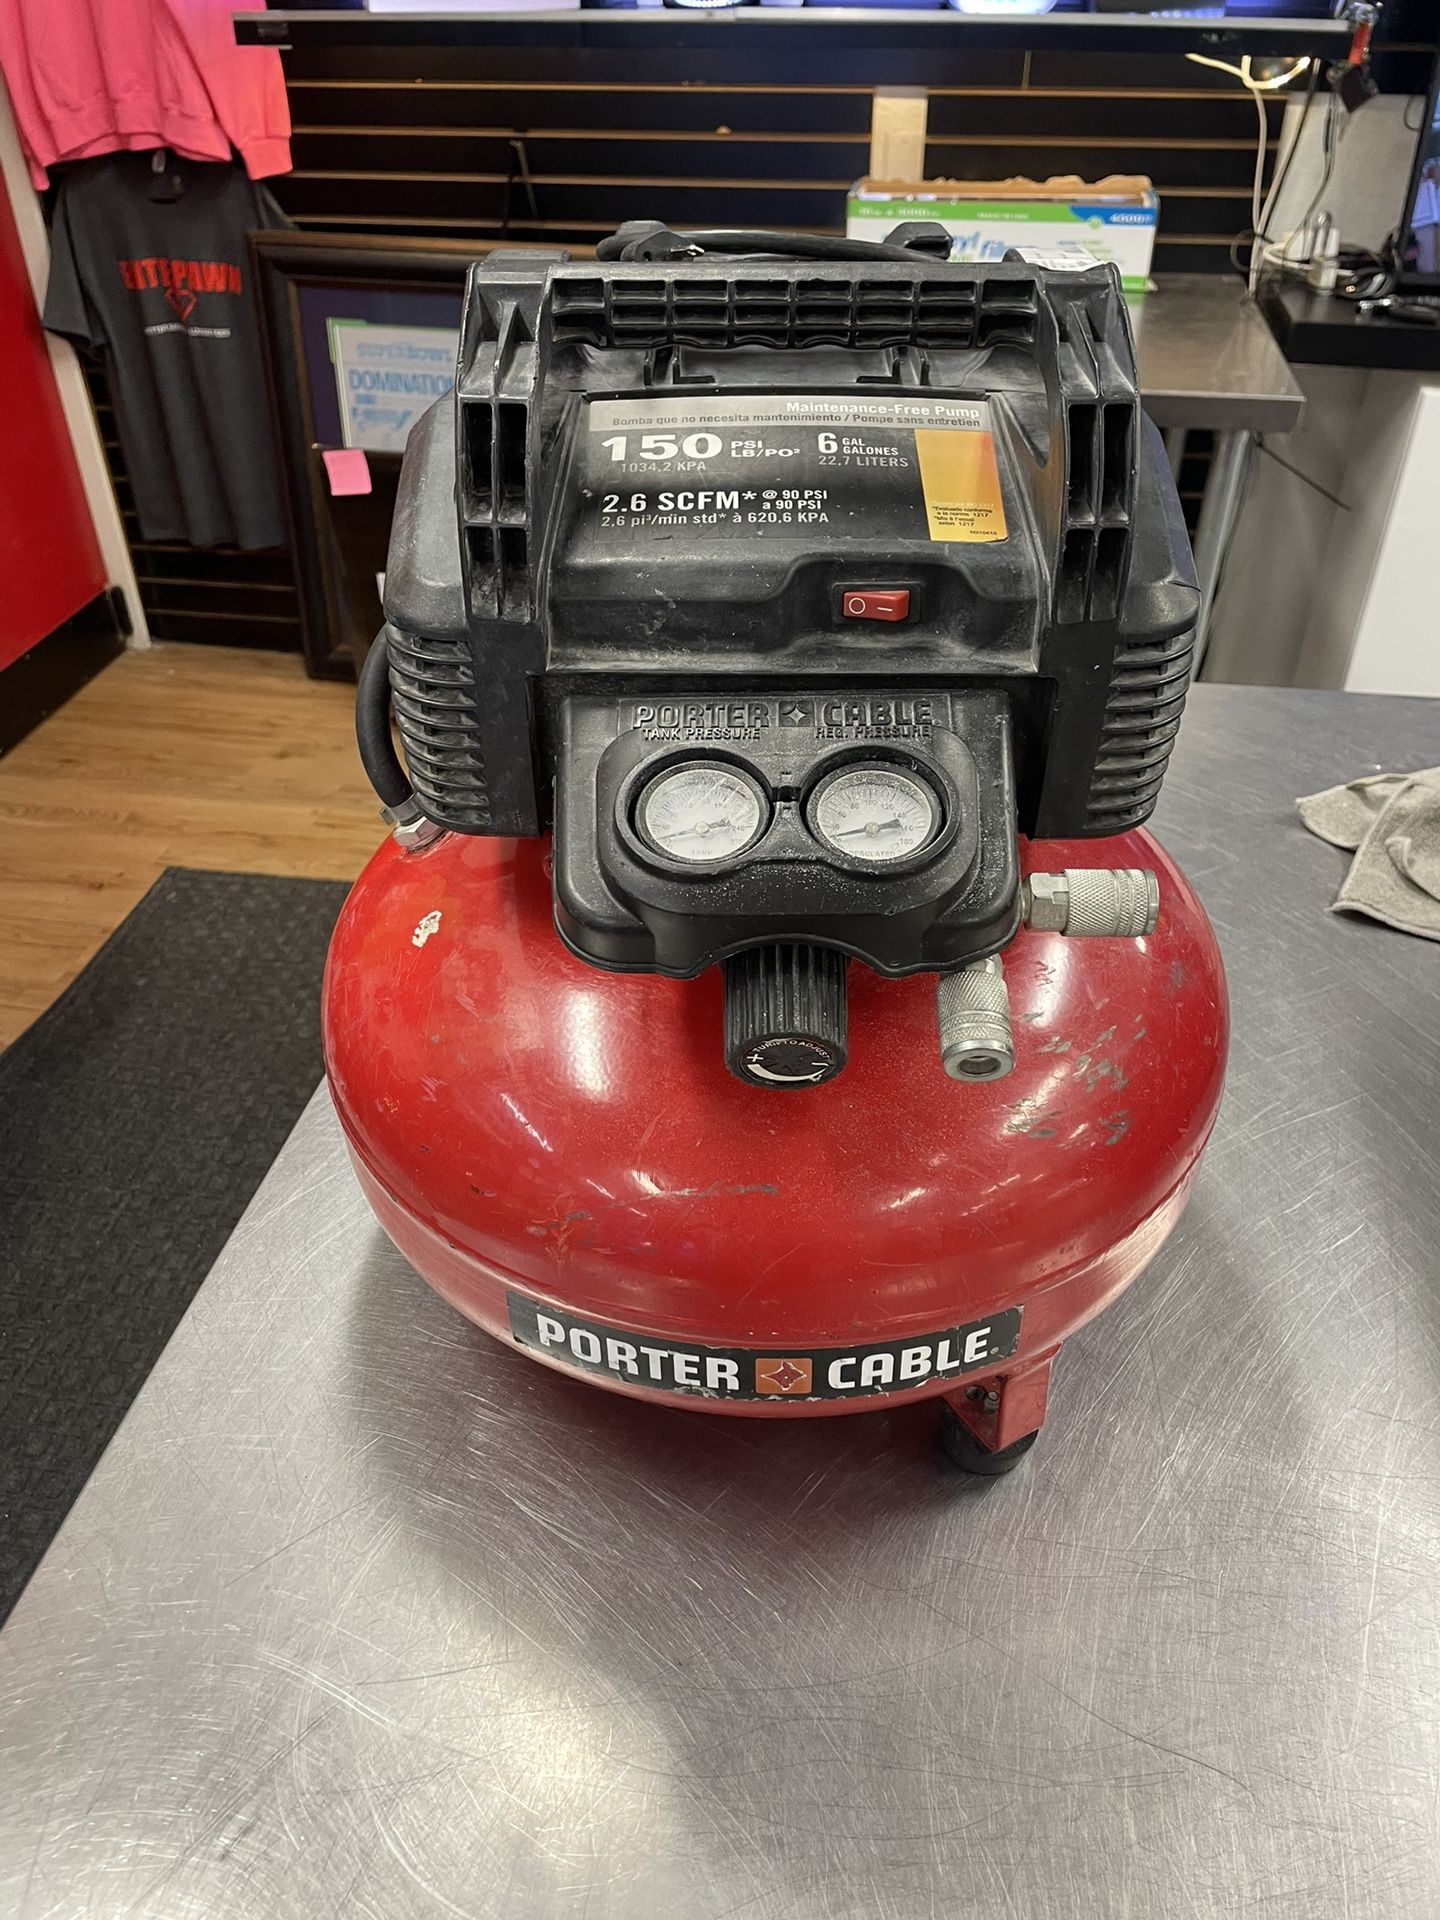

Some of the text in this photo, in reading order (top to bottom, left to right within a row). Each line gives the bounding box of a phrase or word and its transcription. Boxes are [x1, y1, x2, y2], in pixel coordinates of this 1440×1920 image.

[786, 402, 980, 419] Maintenance-Free Pump
[612, 417, 653, 427] Bomba
[656, 416, 678, 426] que
[681, 415, 696, 424] no
[699, 413, 750, 423] necesita
[753, 413, 842, 423] mantenimiento
[852, 414, 894, 425] Pompe
[896, 416, 925, 425] sans
[927, 416, 981, 428] entretien
[601, 432, 723, 461] 150
[730, 440, 763, 449] PSI
[817, 432, 838, 454] 6
[842, 437, 865, 447] GAL
[843, 446, 899, 456] GALONES
[676, 461, 707, 472] KPA
[856, 456, 909, 467] LITERS
[761, 489, 828, 500] @ 90 PSI
[602, 493, 647, 513] 2.6
[762, 499, 822, 510] a 90 PSI
[797, 512, 829, 523] KPA
[632, 700, 933, 729] PORTER CABLE
[643, 727, 761, 740] TANK PRESSURE
[815, 726, 931, 739] REG. PRESSURE
[752, 1038, 782, 1053] TURN
[799, 1040, 831, 1060] ADJUST
[535, 1312, 991, 1391] PORTER CABLE
